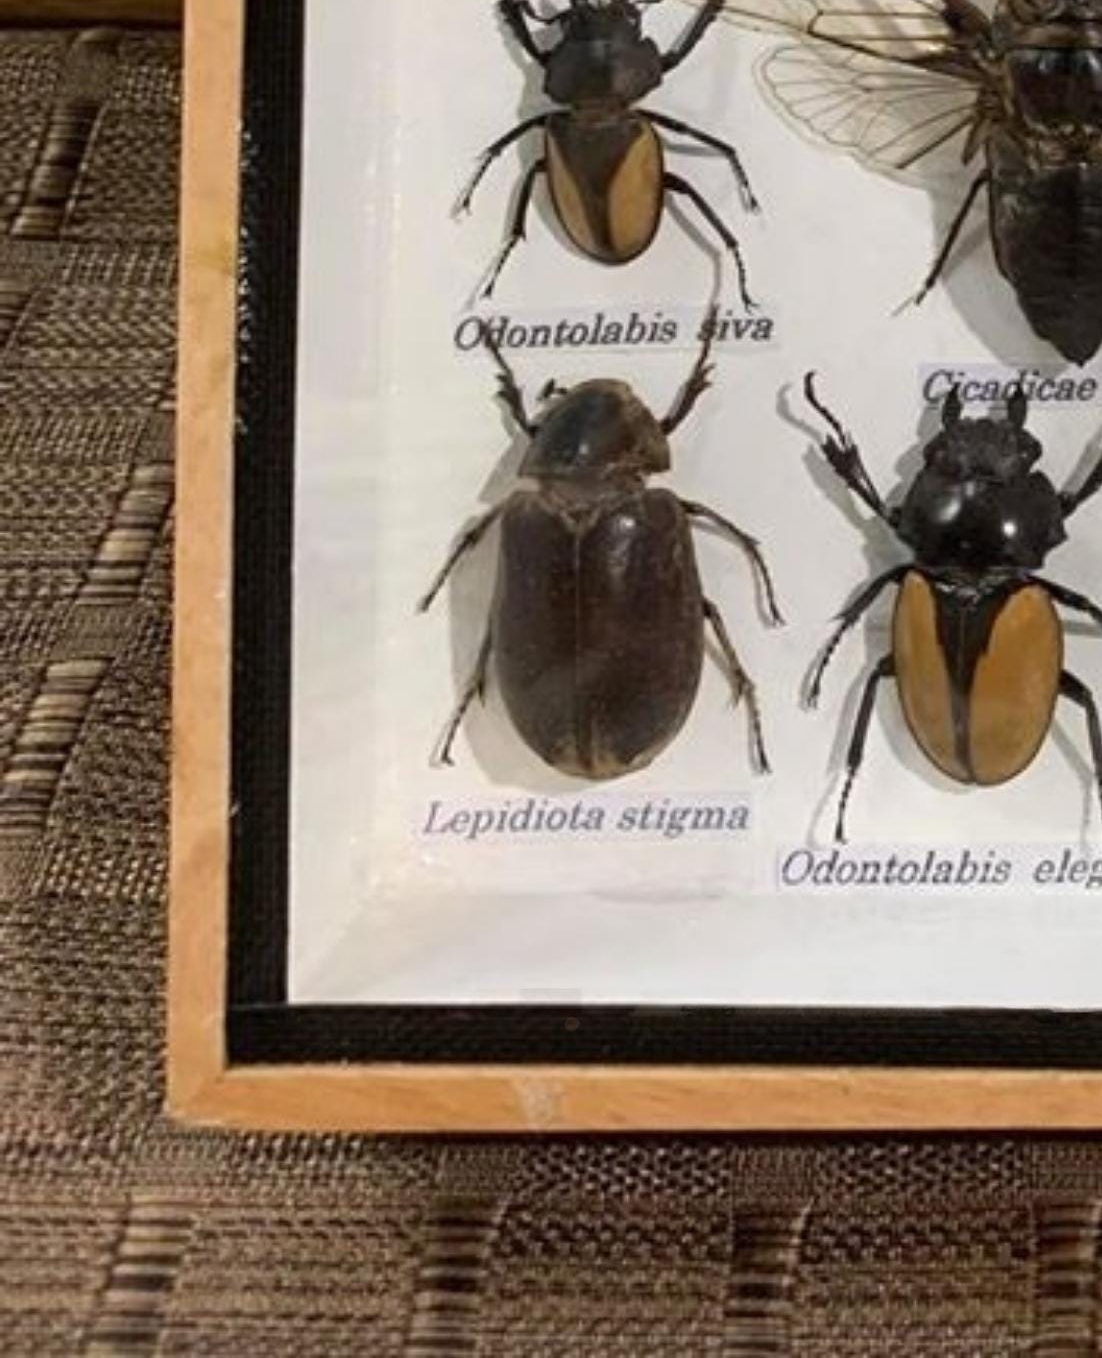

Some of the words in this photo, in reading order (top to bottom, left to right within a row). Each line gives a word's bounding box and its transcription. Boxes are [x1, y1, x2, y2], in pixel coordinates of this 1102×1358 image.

[453, 312, 678, 351] Odontolabis
[423, 799, 606, 840] Lepidiota
[616, 798, 749, 838] stigma
[781, 849, 1012, 886] Odontolabis
